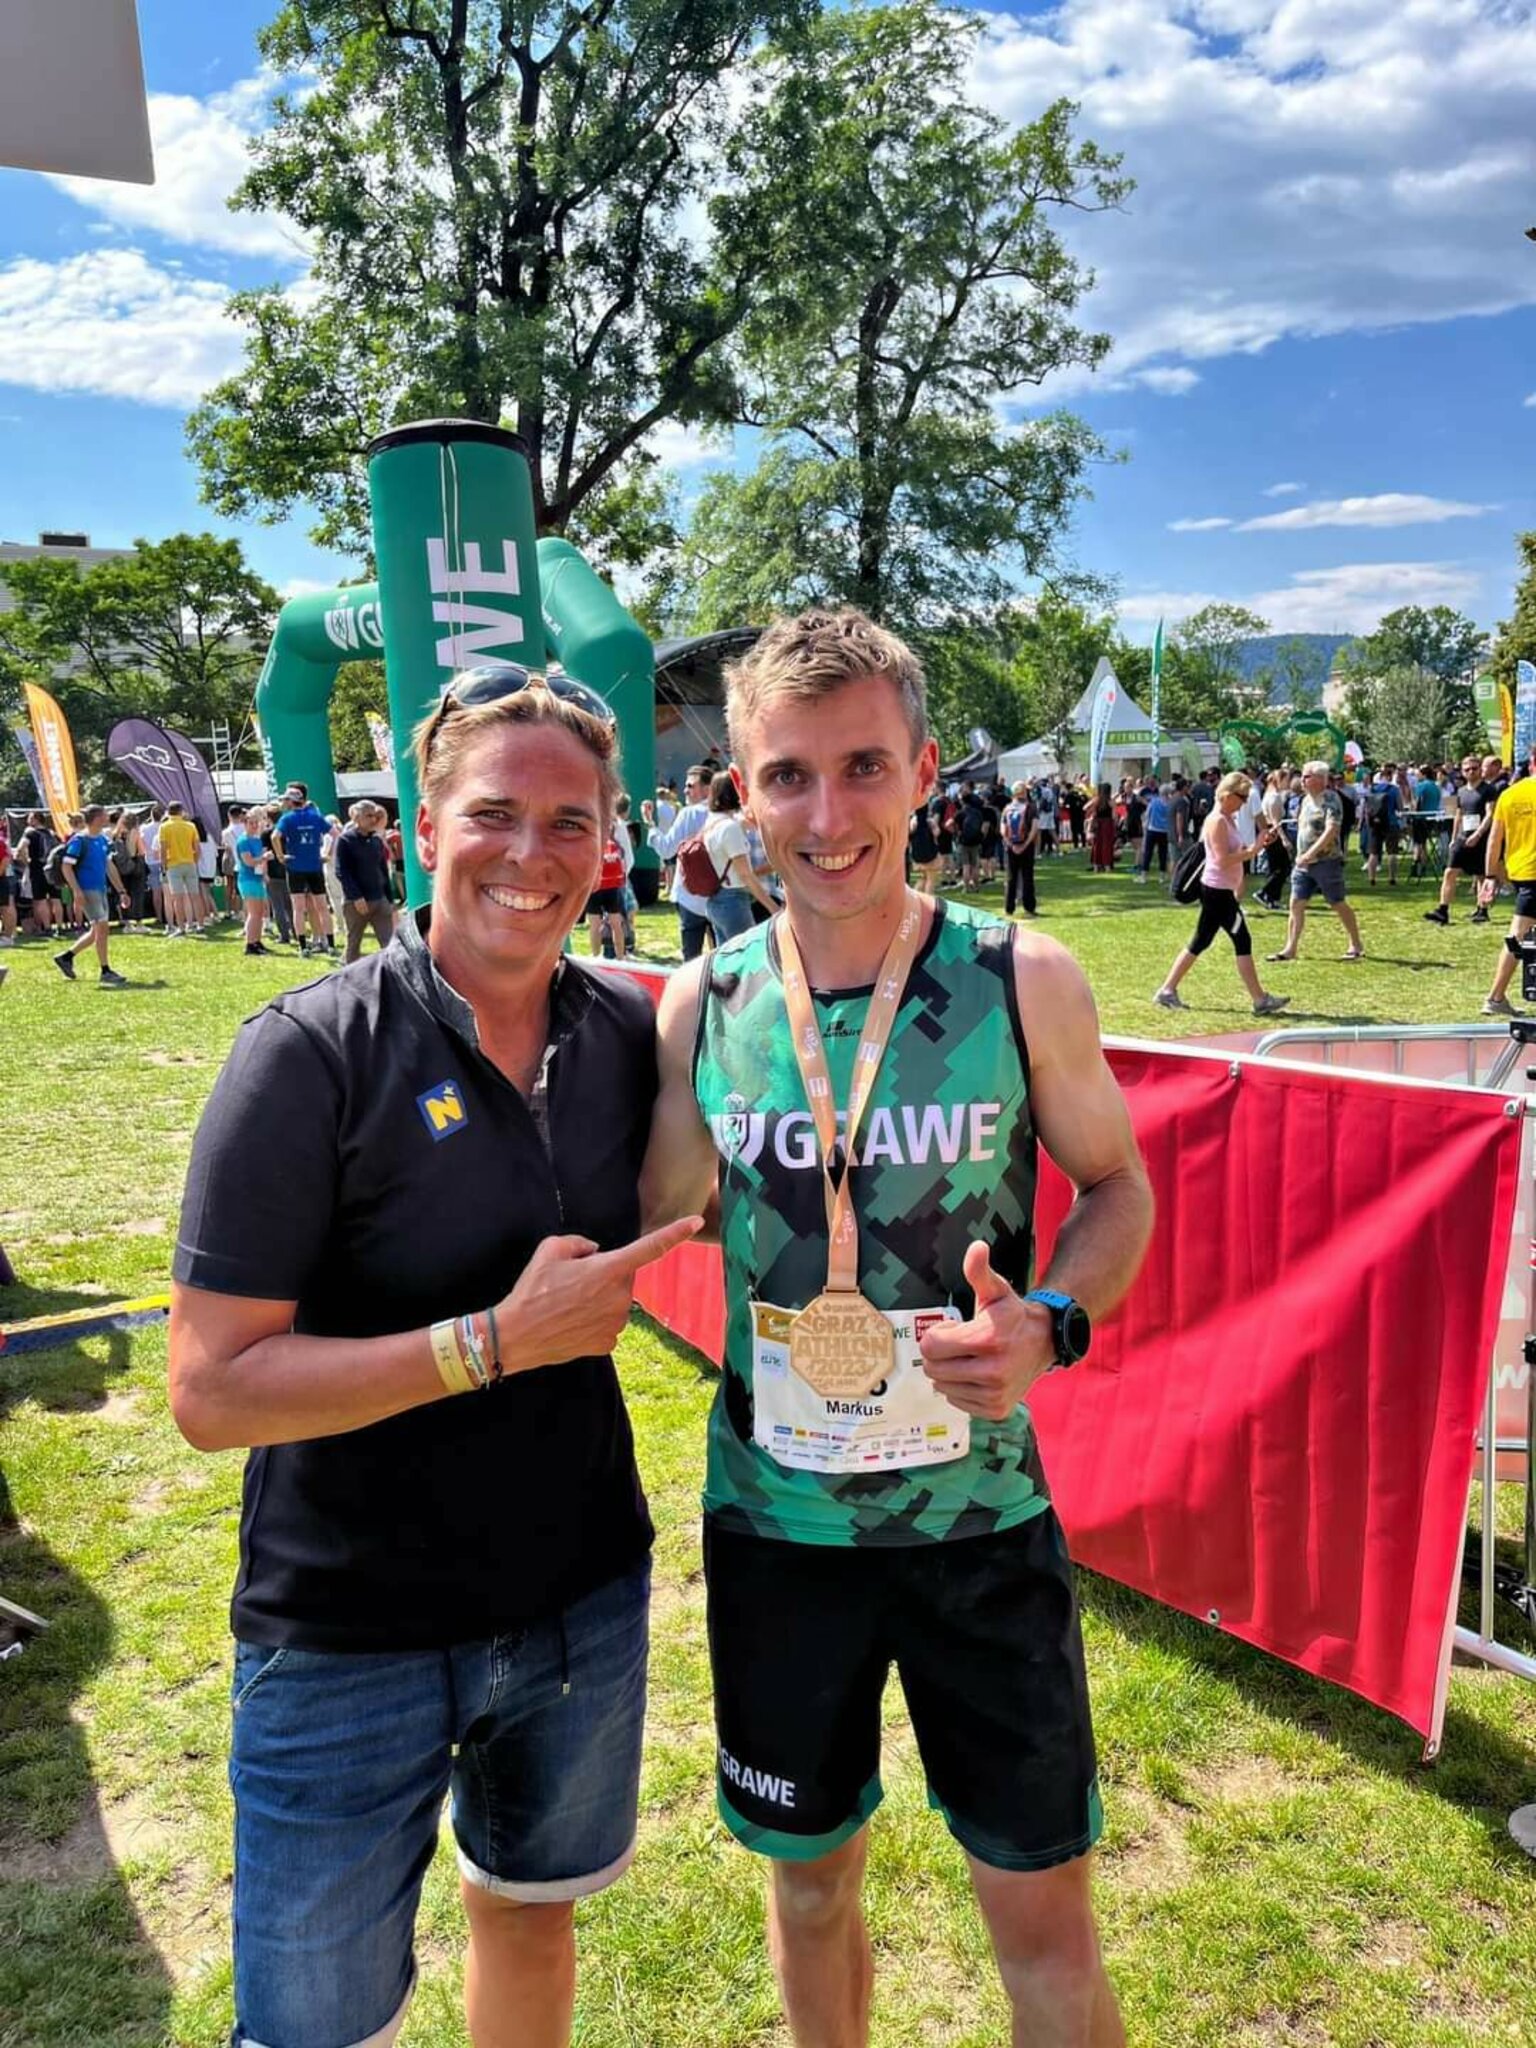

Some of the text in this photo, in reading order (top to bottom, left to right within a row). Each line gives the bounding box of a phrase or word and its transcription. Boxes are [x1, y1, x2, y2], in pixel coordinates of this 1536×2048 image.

[426, 538, 525, 673] WE
[812, 1315, 867, 1334] GRAZ
[795, 1335, 889, 1358] ATHLON
[826, 1400, 884, 1417] Markus
[721, 1746, 796, 1808] GRAWE
